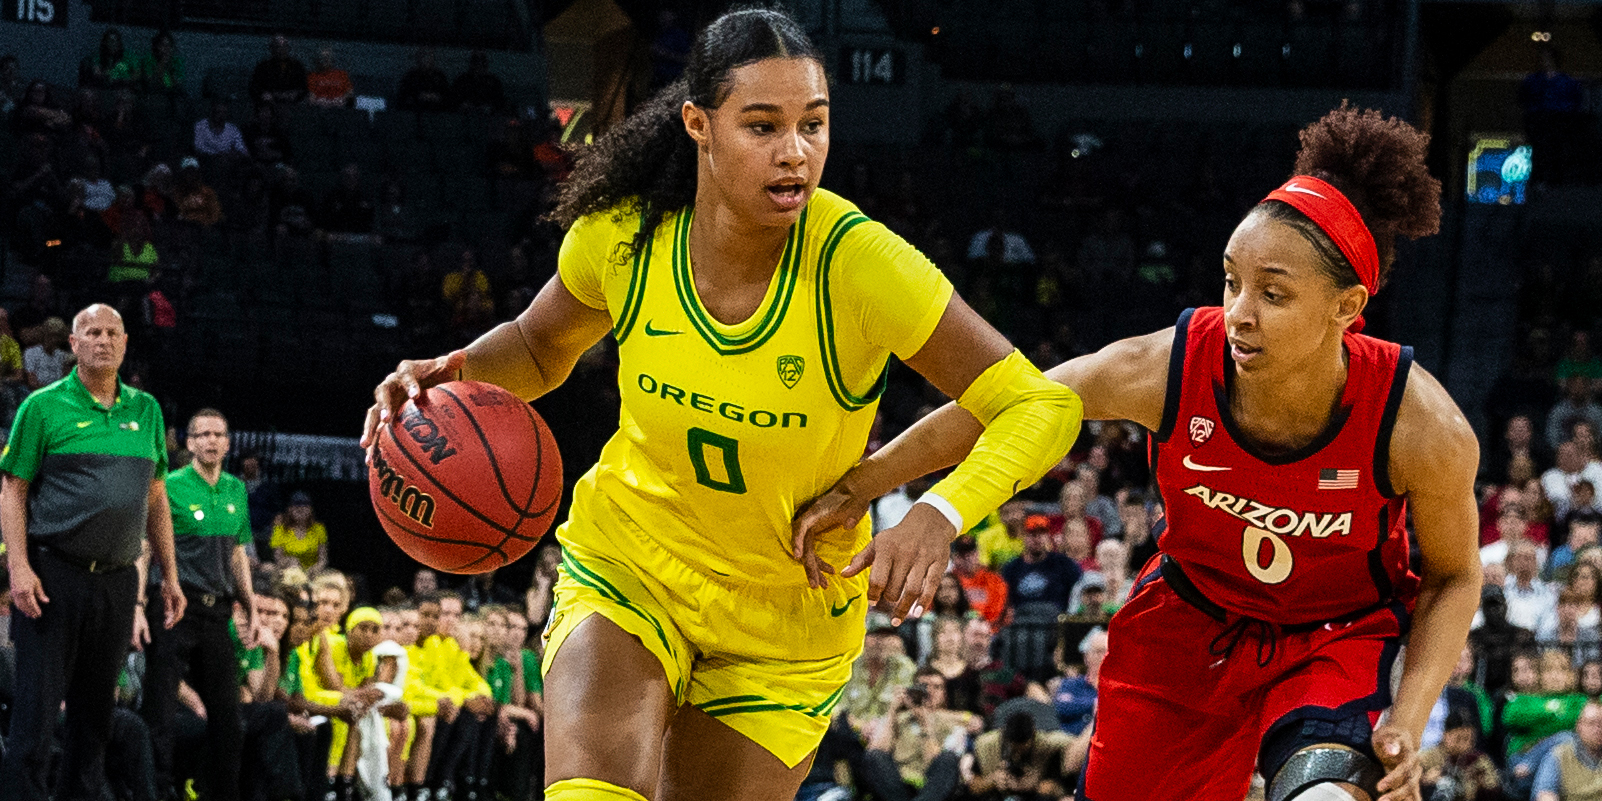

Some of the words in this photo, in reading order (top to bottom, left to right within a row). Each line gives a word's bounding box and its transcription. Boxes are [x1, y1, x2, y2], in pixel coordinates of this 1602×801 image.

[17, 0, 55, 23] 115
[852, 50, 892, 82] 114
[779, 357, 803, 375] PAC
[780, 369, 797, 381] 12
[637, 373, 808, 428] OREGON
[1190, 416, 1214, 438] PAC
[1191, 429, 1205, 443] 12
[687, 426, 748, 495] 0
[1182, 483, 1354, 539] ARIZONA
[1242, 524, 1294, 585] 0
